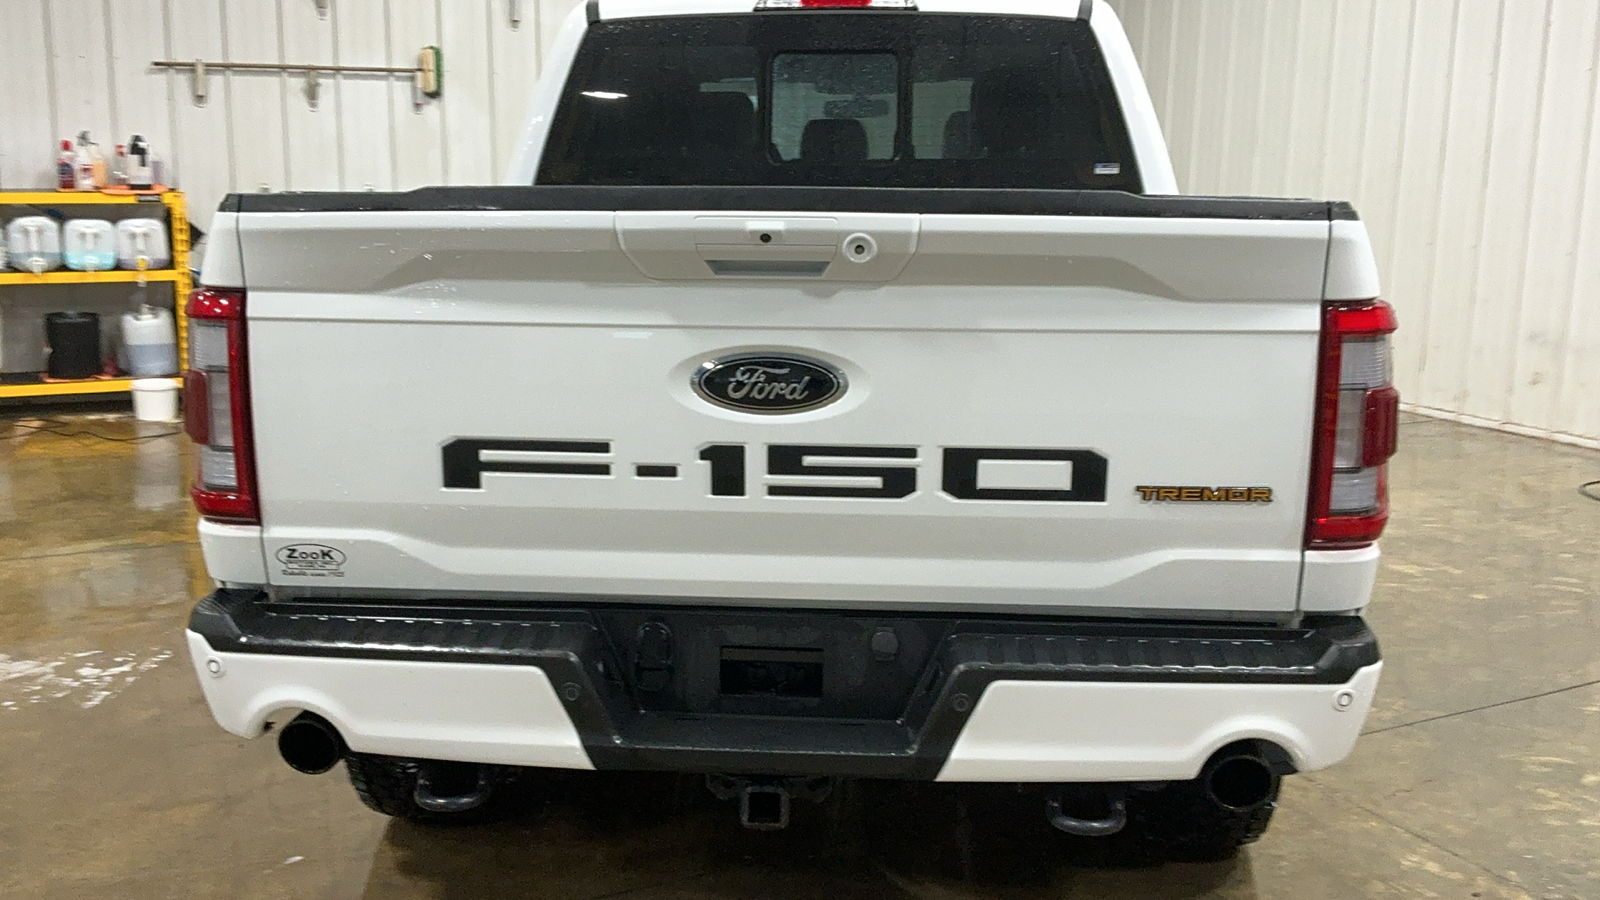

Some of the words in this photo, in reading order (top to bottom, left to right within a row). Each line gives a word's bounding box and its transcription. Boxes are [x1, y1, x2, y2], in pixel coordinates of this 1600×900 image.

[726, 366, 811, 401] Ford
[441, 437, 1108, 503] F-150
[1136, 485, 1274, 503] TREMOR
